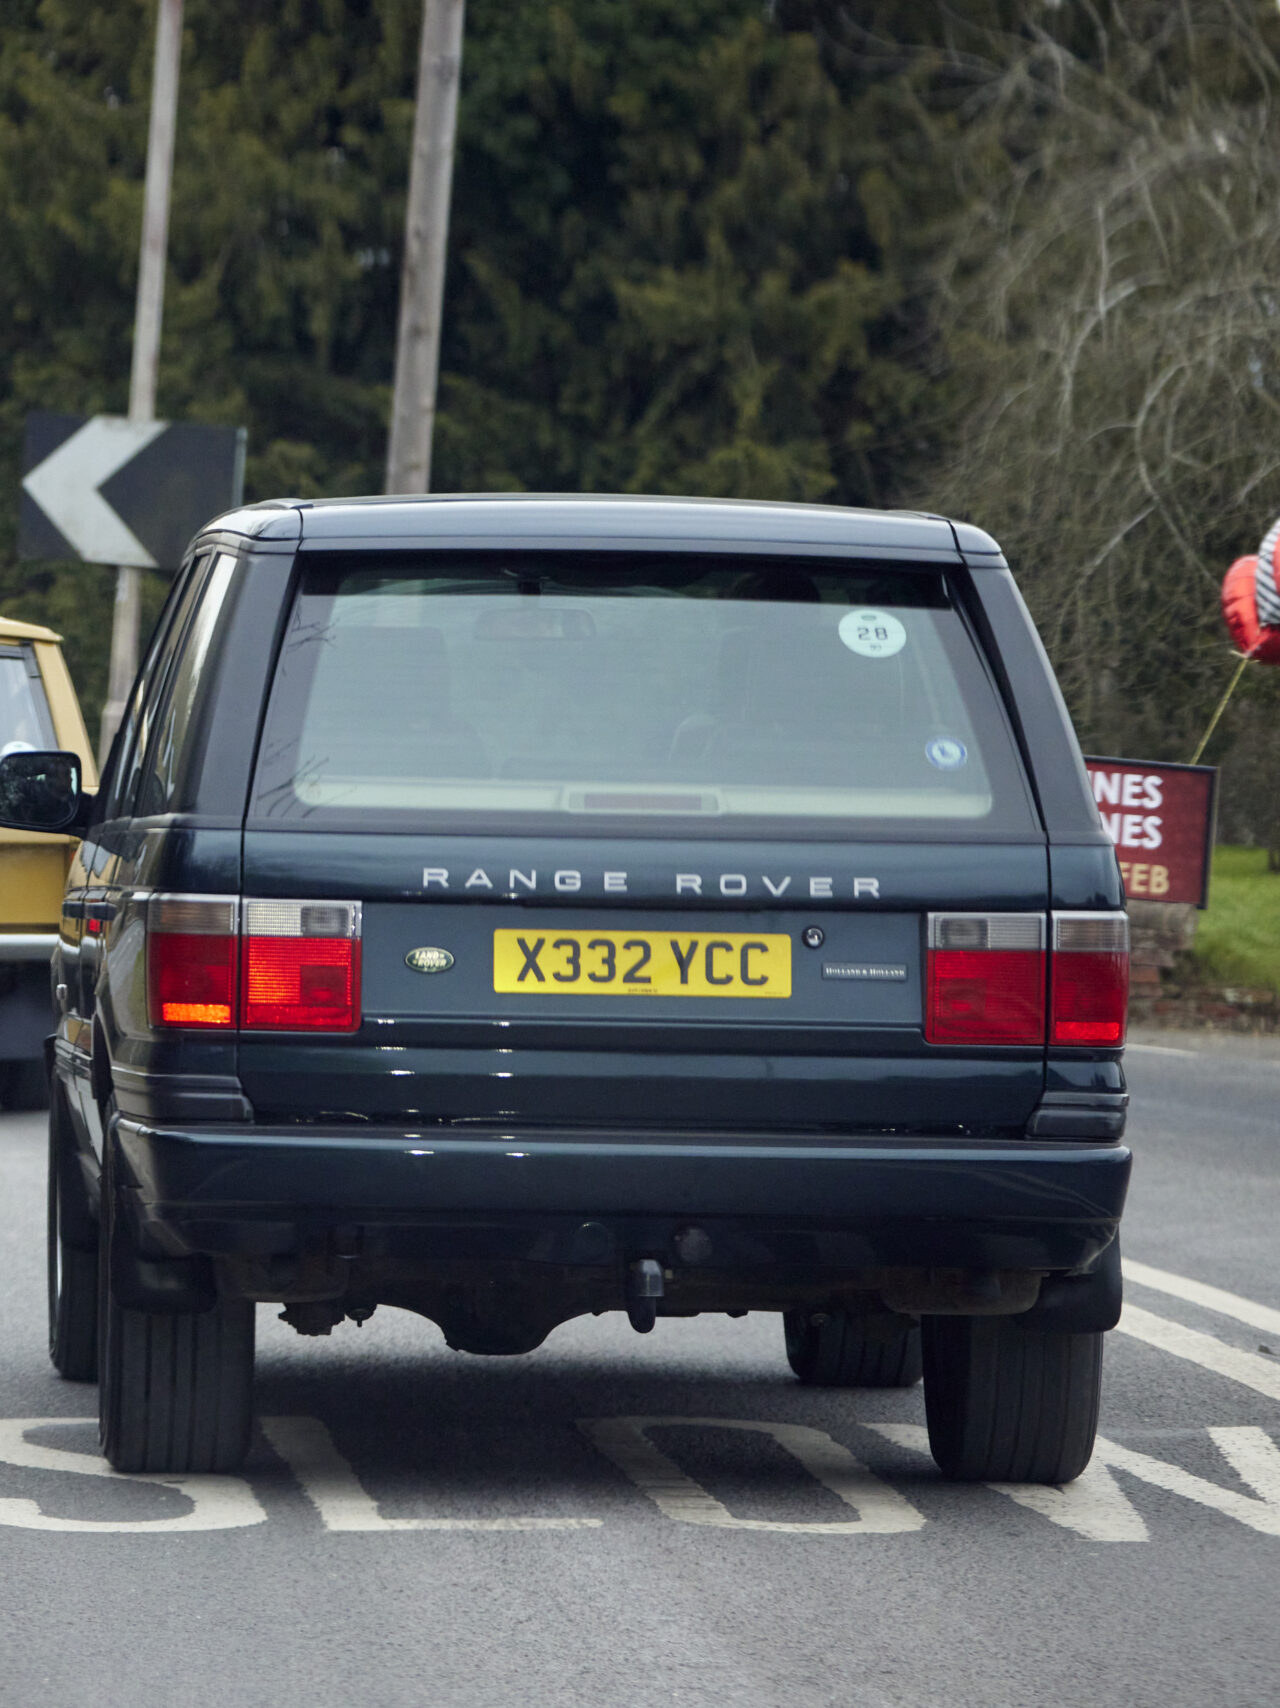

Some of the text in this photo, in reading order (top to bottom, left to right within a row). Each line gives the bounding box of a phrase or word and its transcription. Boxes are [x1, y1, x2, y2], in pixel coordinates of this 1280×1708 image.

[857, 626, 889, 641] 28
[1087, 770, 1163, 809] NES
[422, 867, 881, 897] RANGE ROVER
[516, 937, 770, 987] X332 YCC
